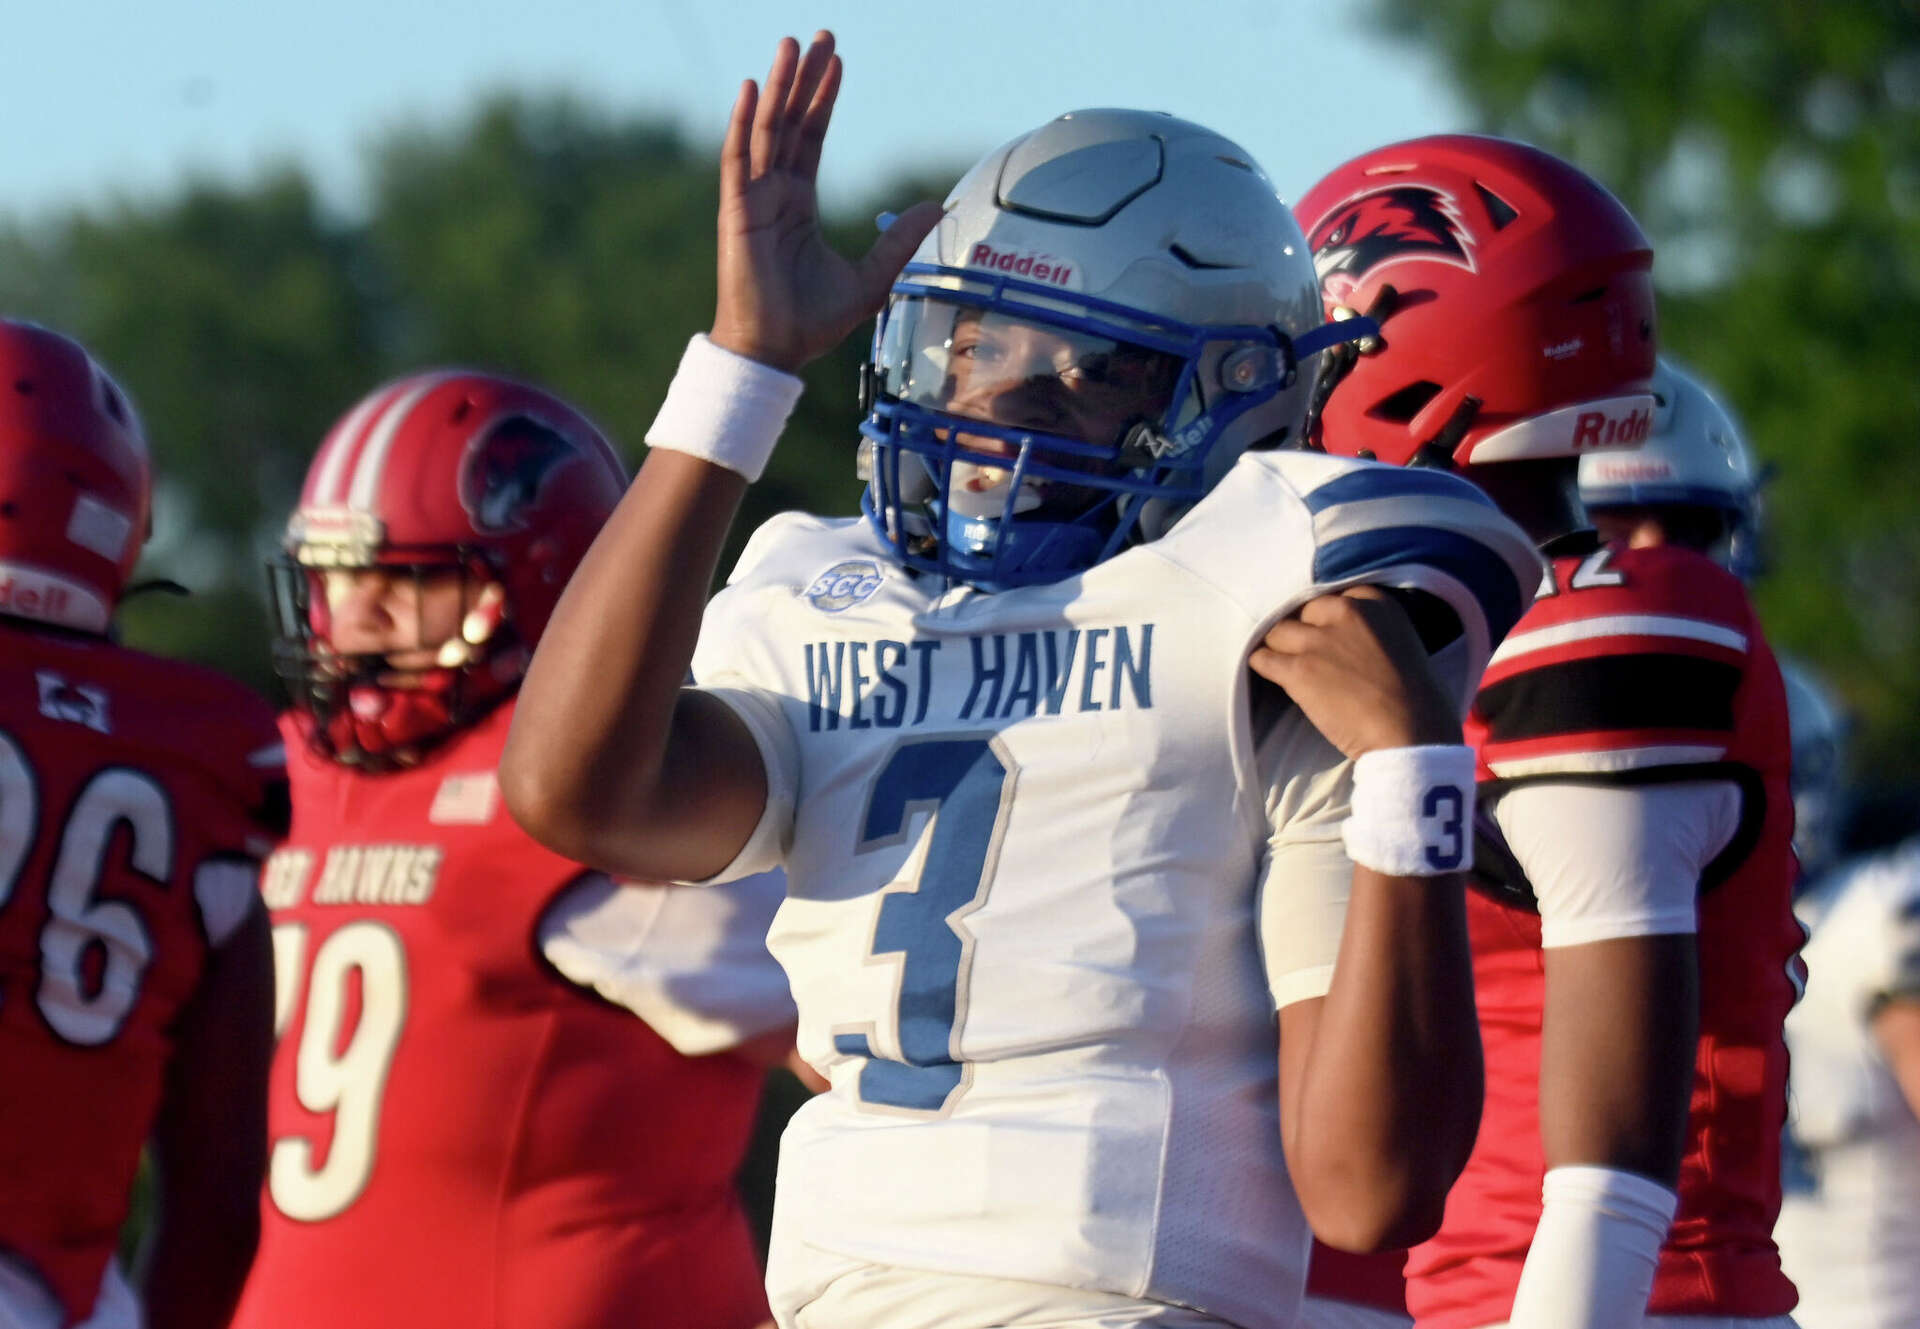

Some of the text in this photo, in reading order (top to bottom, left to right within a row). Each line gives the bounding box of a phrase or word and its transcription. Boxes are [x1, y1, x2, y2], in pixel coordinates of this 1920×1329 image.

[970, 244, 1072, 285] Riddell
[807, 573, 884, 600] SCC
[804, 624, 1155, 732] WEST HAVEN
[1422, 784, 1464, 871] 3
[312, 843, 443, 905] HAWKS
[832, 731, 1021, 1119] 3
